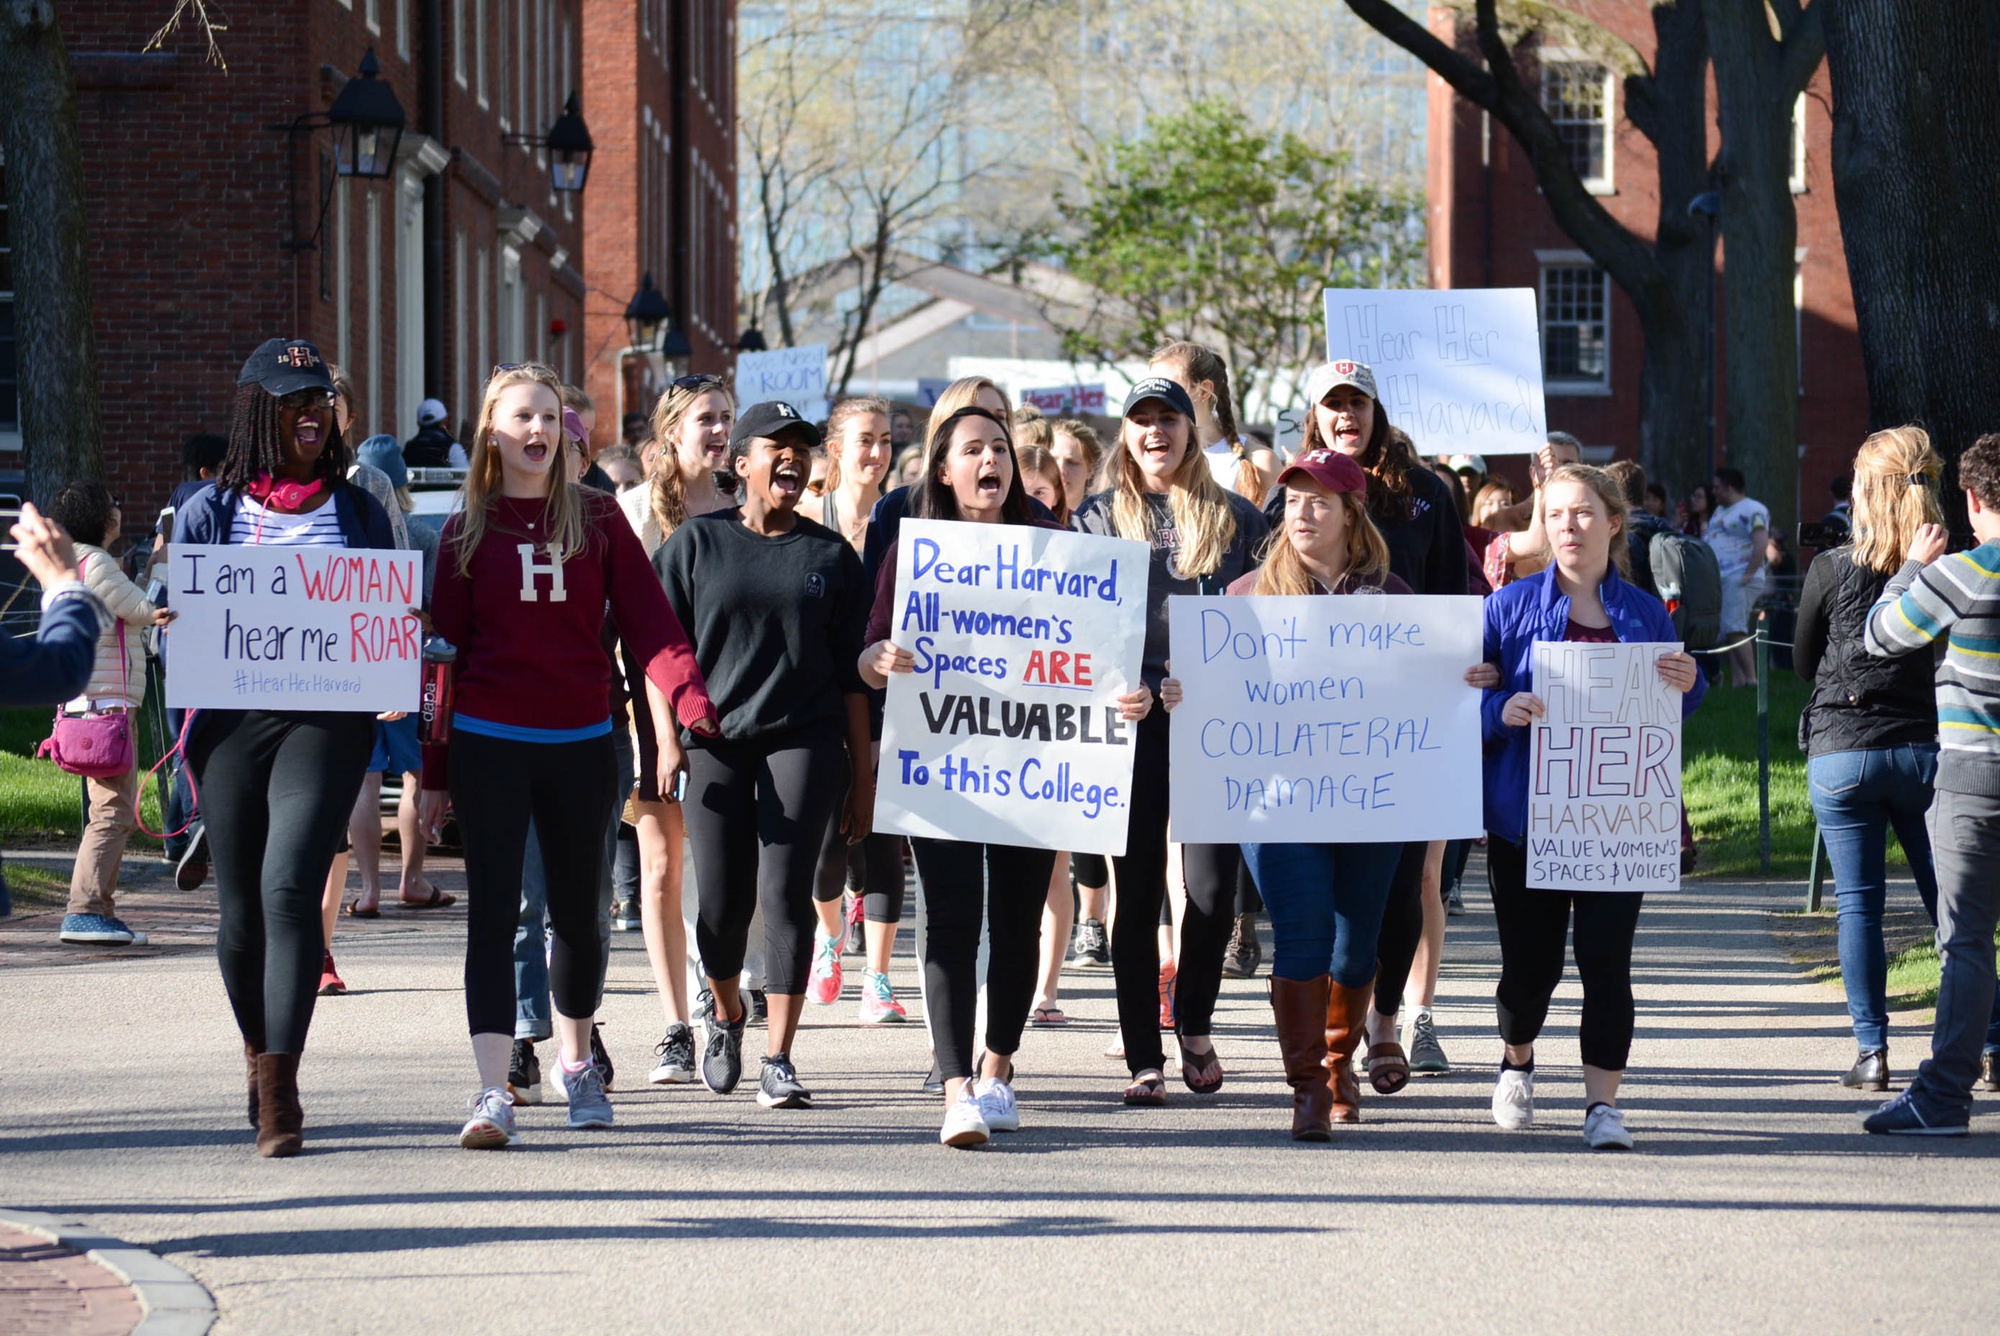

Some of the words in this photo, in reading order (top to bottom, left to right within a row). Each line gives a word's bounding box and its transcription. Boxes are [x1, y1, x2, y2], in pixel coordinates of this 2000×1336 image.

[277, 355, 289, 363] 16
[287, 346, 314, 367] H
[1344, 304, 1422, 364] Hear
[1434, 304, 1499, 362] Her
[761, 367, 823, 394] ROOM
[1339, 363, 1349, 373] H
[776, 403, 796, 418] H
[1022, 389, 1065, 408] Hear
[1071, 385, 1104, 407] Her
[1386, 374, 1538, 441] Harvard
[1303, 450, 1332, 465] H
[182, 554, 206, 594] I
[215, 564, 254, 594] am
[271, 565, 287, 595] a
[295, 553, 413, 604] WOMAN
[517, 542, 567, 602] H
[913, 538, 990, 586] Dear
[996, 544, 1122, 606] Harvard,
[224, 608, 294, 661] hear
[301, 628, 338, 662] me
[350, 612, 419, 663] ROAR
[901, 590, 1073, 644] All-women's
[1201, 609, 1307, 664] Don't
[1329, 622, 1425, 650] make
[912, 637, 1008, 690] Spaces
[1022, 650, 1093, 686] ARE
[1540, 645, 1679, 725] HEAR
[1245, 676, 1364, 706] women
[919, 692, 1128, 745] VALUABLE
[1201, 717, 1441, 758] COLLATERAL
[898, 748, 930, 786] To
[939, 754, 1011, 797] this
[1019, 757, 1126, 819] College.
[1536, 726, 1676, 799] HER
[1224, 772, 1395, 812] DAMAGE
[1532, 801, 1679, 835] HARVARD
[1531, 838, 1594, 859] VALUE
[1600, 839, 1677, 858] WOMEN'S
[1533, 860, 1606, 882] SPACES
[1624, 861, 1677, 883] VOICES
